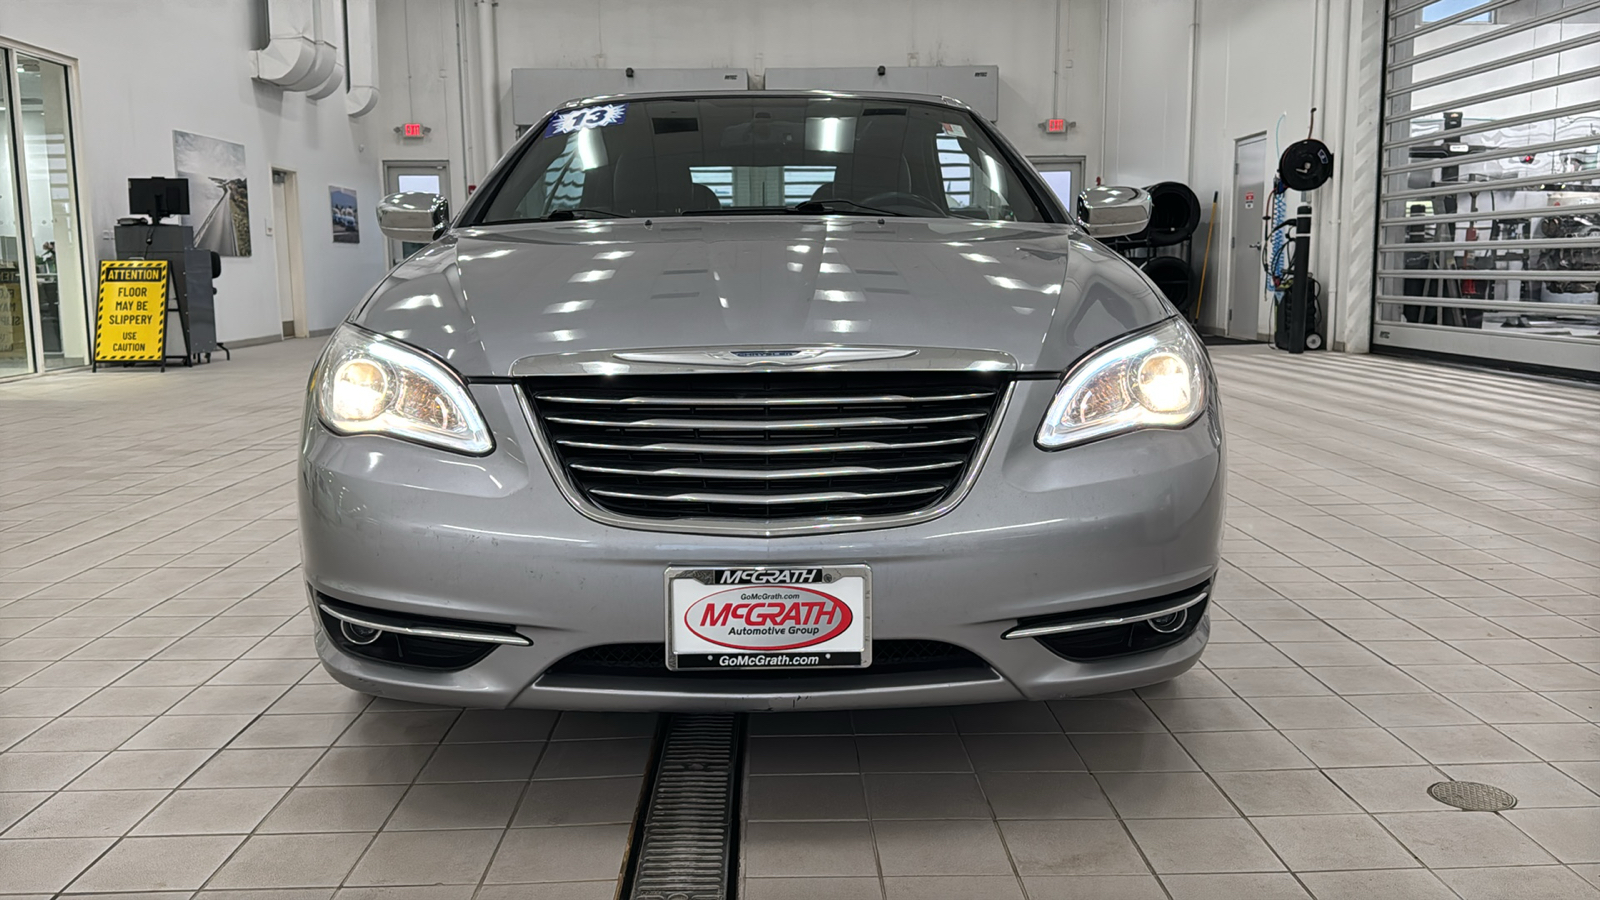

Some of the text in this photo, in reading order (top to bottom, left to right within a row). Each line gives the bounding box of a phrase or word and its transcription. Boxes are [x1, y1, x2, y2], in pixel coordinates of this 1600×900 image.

[572, 109, 608, 127] 13
[405, 124, 420, 136] EXIT
[1049, 119, 1063, 131] EXIT
[107, 269, 159, 281] ATTENTION
[118, 287, 147, 298] FLOOR
[115, 301, 148, 311] MAY BE
[109, 314, 153, 325] SLIPPERY
[122, 332, 137, 341] USE
[113, 343, 146, 352] CAUTION
[740, 593, 800, 601] GoMcGrath.com
[728, 626, 820, 637] Automotive Group
[719, 654, 819, 666] GoMcGrath.com
